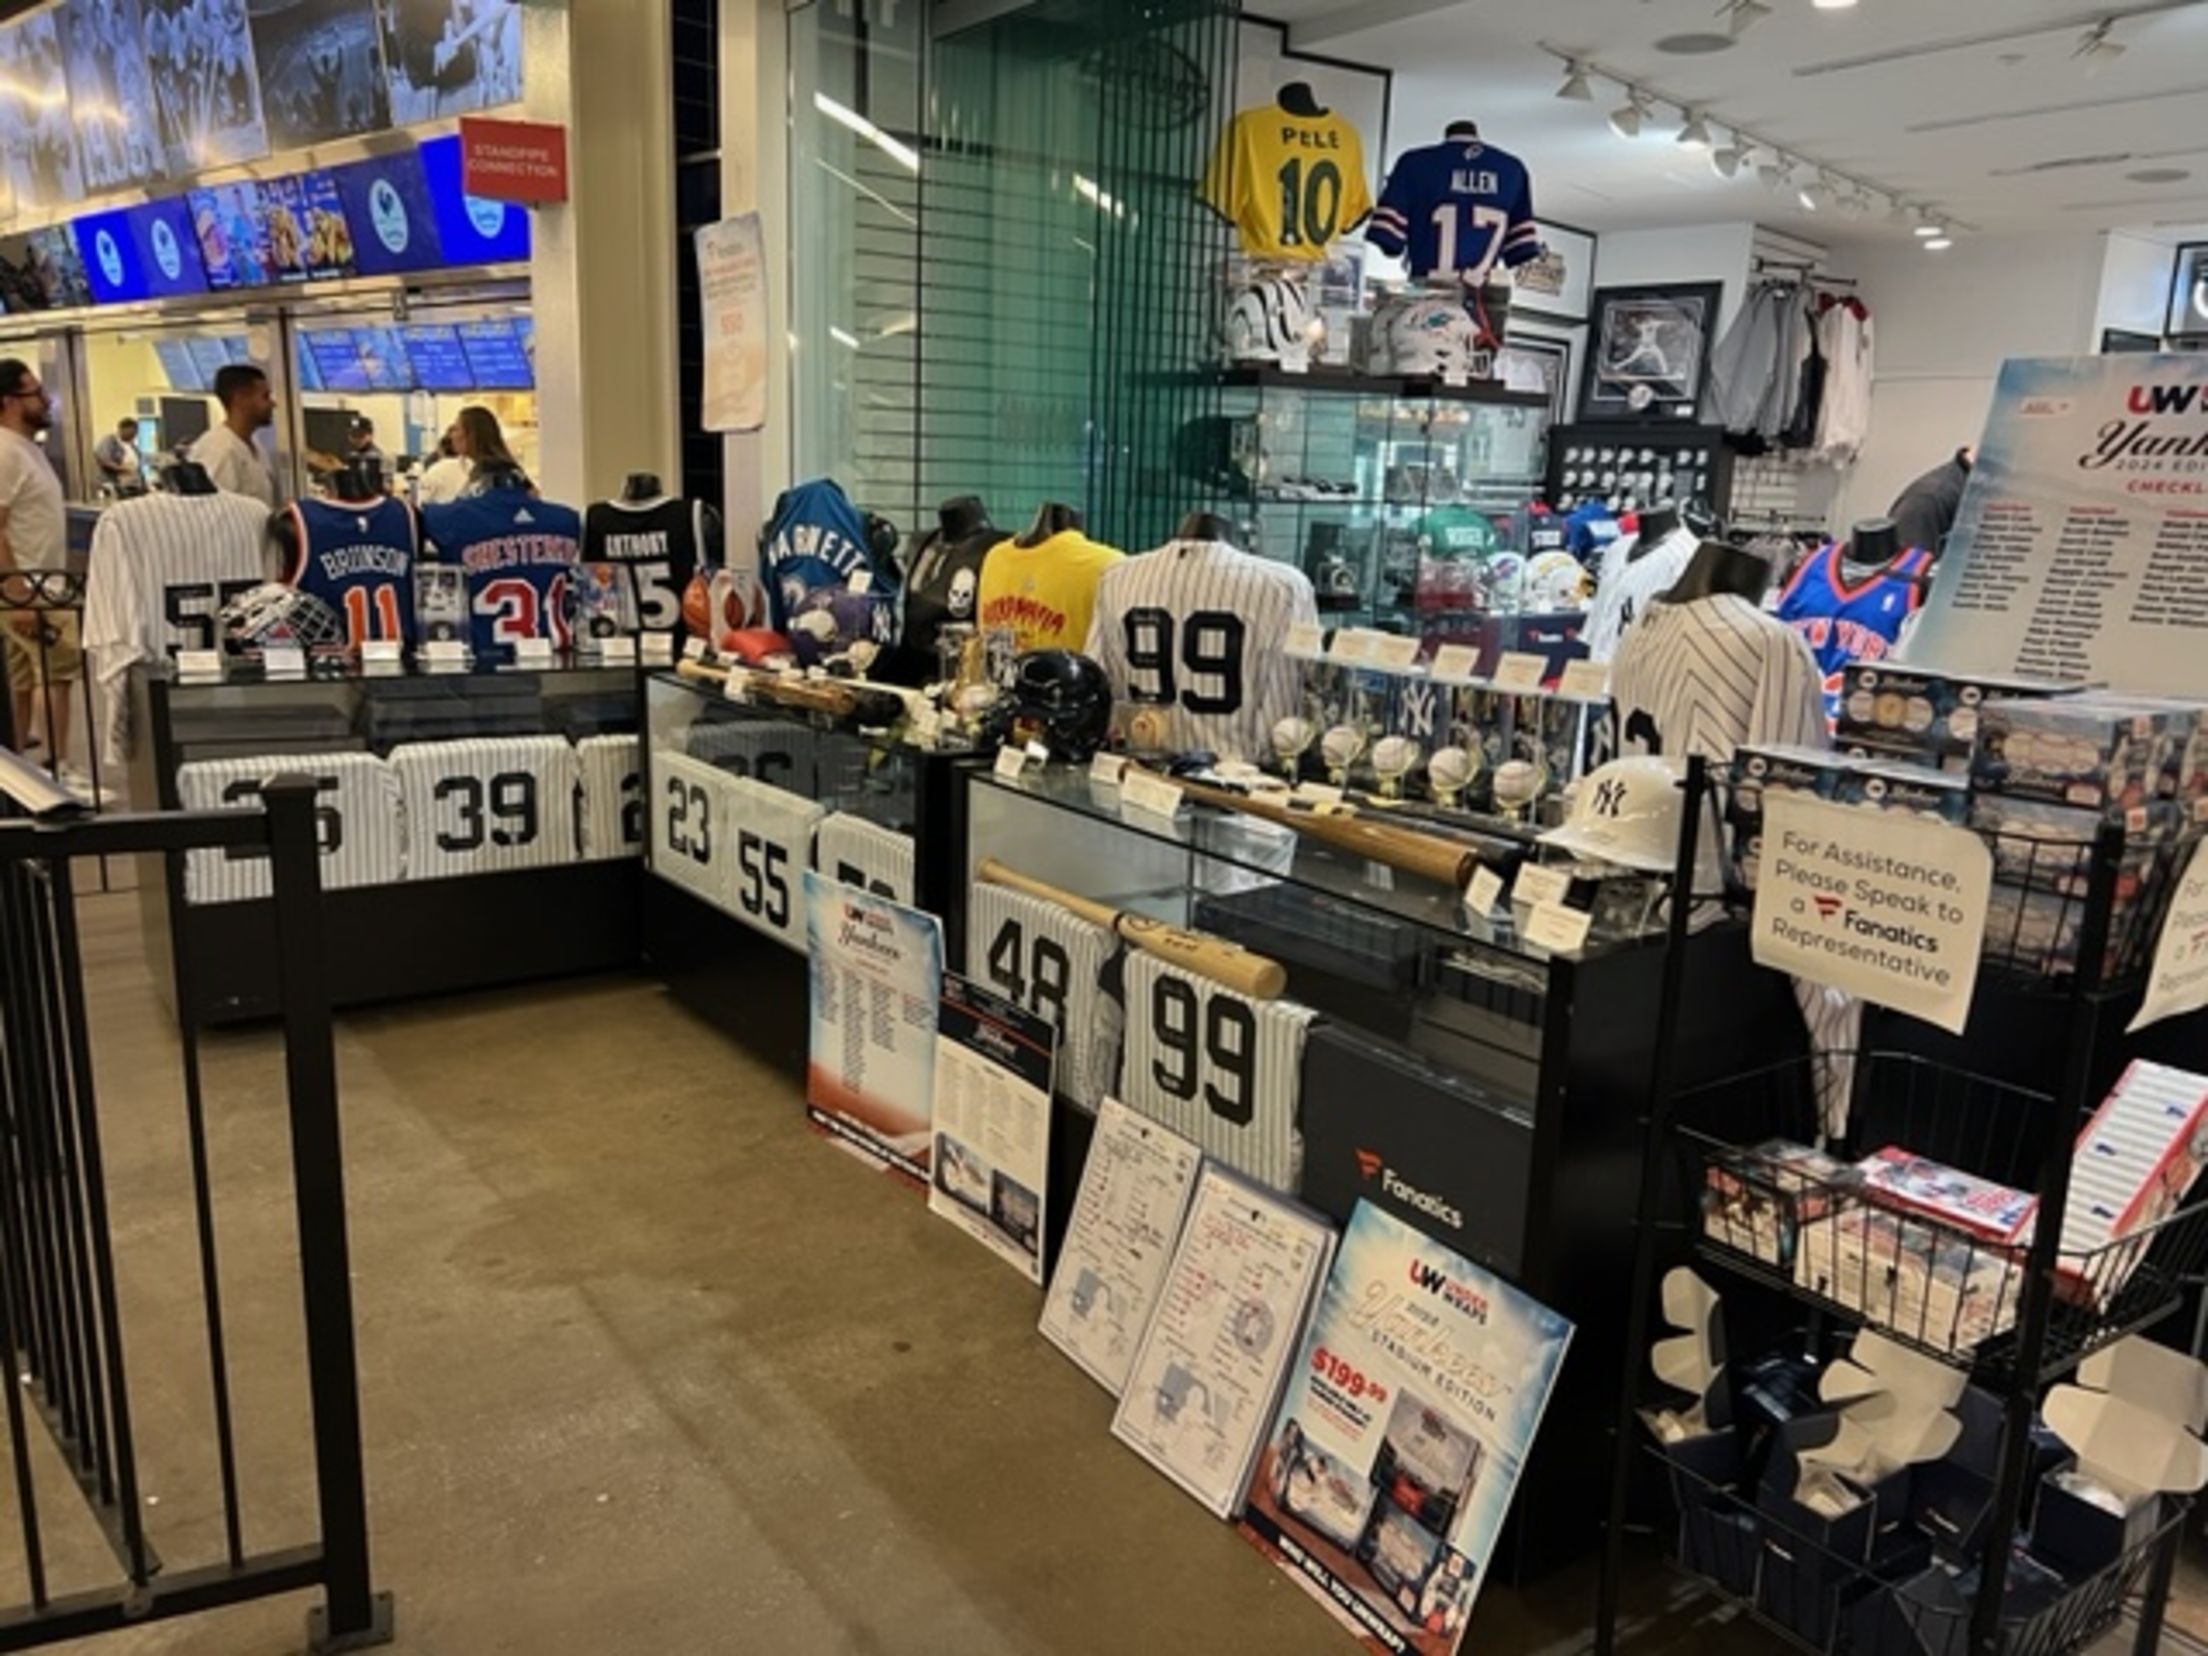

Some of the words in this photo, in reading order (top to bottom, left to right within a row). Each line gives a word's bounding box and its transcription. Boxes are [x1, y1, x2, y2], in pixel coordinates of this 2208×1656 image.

[467, 158, 559, 177] CONNECTION
[1278, 158, 1342, 246] 10
[1451, 169, 1498, 194] ALLEN
[1428, 203, 1508, 288] 17
[2127, 384, 2199, 415] UW
[320, 544, 410, 580] BRUNSON
[343, 583, 403, 656] 11
[1124, 606, 1246, 715] 99
[435, 771, 538, 853] 39
[667, 775, 710, 865] 23
[1782, 830, 1820, 857] For
[738, 827, 790, 930] 55
[1775, 858, 1849, 895] Please
[1854, 878, 1931, 916] Speak
[1937, 902, 1965, 925] to
[1772, 917, 1951, 988] Representative
[1790, 897, 1806, 914] a
[1843, 909, 1940, 954] Fanatics
[987, 917, 1070, 1049] 48
[1152, 972, 1256, 1128] 99
[1381, 1167, 1464, 1230] Fanatics
[1409, 1258, 1447, 1296] UW
[1371, 1328, 1434, 1376] STADIUM
[1434, 1371, 1498, 1424] EDITION
